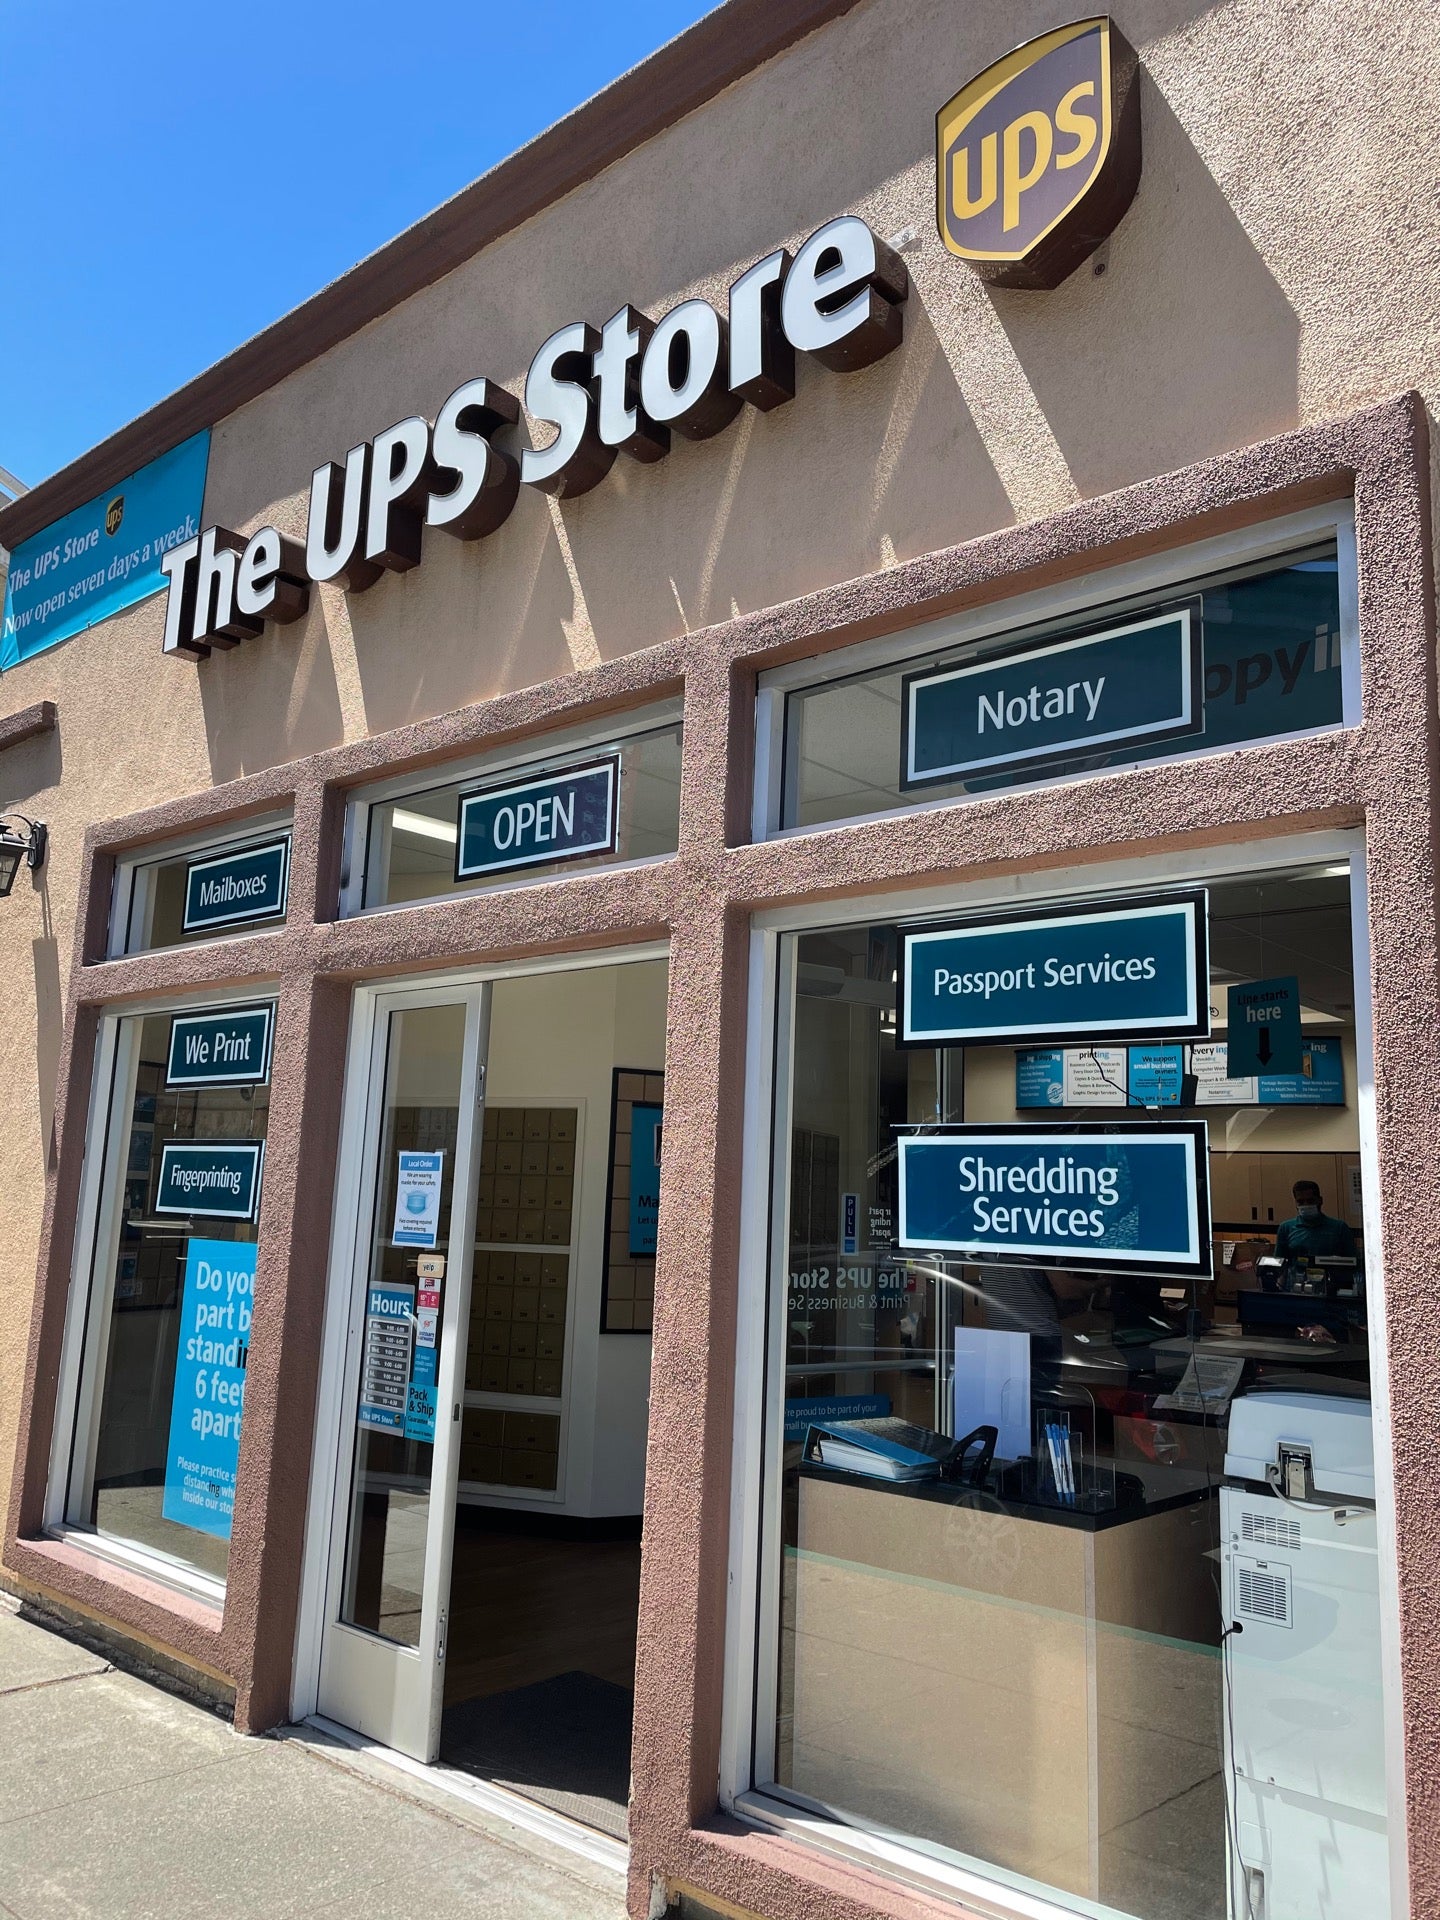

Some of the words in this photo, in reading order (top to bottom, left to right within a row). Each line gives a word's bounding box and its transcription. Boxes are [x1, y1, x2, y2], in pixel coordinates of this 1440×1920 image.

[952, 80, 1098, 233] ups
[161, 524, 281, 654] The
[305, 375, 488, 583] UPS
[521, 215, 877, 484] Store
[106, 506, 123, 529] ups
[4, 607, 33, 638] Now
[34, 592, 65, 623] open
[68, 567, 105, 603] seven
[108, 550, 139, 584] days
[141, 544, 151, 561] a
[153, 513, 199, 557] week.
[10, 568, 30, 594] The
[34, 551, 60, 580] UPS
[62, 527, 98, 564] Store
[976, 675, 1106, 735] Notary
[493, 791, 575, 851] OPEN
[199, 873, 268, 907] Mailboxes
[933, 961, 1036, 1000] Passport
[1043, 952, 1156, 988] Services
[1237, 995, 1260, 1006] Line
[1261, 989, 1289, 1001] starts
[1245, 1005, 1282, 1023] here
[185, 1034, 208, 1064] We
[212, 1030, 252, 1063] Print
[1079, 1050, 1110, 1060] printing
[1153, 1055, 1177, 1064] support
[170, 1163, 242, 1195] Fingerprinting
[958, 1155, 1120, 1206] Shredding
[972, 1195, 1106, 1237] Services
[196, 1261, 223, 1292] Do
[195, 1301, 235, 1333] part
[238, 1300, 251, 1332] b
[370, 1293, 411, 1316] Hours
[195, 1369, 207, 1400] 6
[409, 1387, 428, 1401] Pack
[191, 1407, 241, 1441] apart
[362, 1411, 371, 1420] The
[371, 1412, 381, 1422] UPS
[381, 1413, 393, 1425] Store
[408, 1400, 415, 1412] &
[416, 1402, 434, 1418] Ship
[795, 1406, 817, 1418] proud
[818, 1407, 825, 1415] to
[827, 1406, 837, 1415] be
[837, 1405, 852, 1416] part
[852, 1404, 861, 1413] of
[861, 1404, 877, 1414] your
[785, 1421, 800, 1431] mall
[177, 1455, 200, 1474] Please
[200, 1464, 230, 1482] practice
[182, 1488, 204, 1506] inside
[205, 1498, 218, 1510] our
[183, 1473, 220, 1498] distancing
